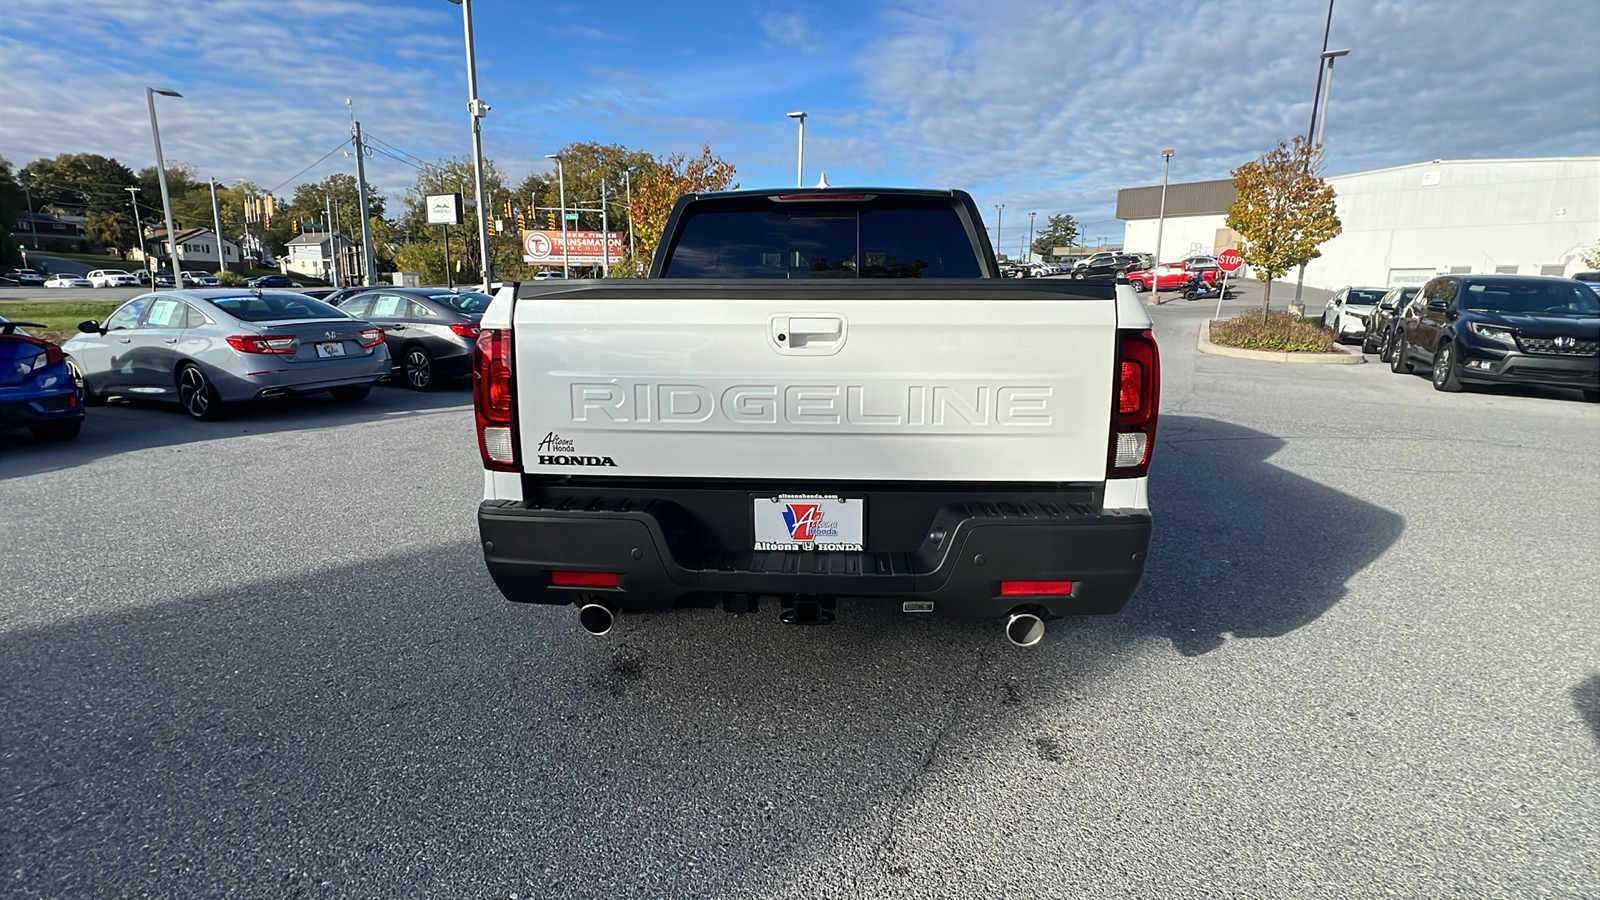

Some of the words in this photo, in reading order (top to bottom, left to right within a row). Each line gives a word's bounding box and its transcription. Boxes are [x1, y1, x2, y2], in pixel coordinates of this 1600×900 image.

[553, 238, 622, 247] TRNS4MATON
[1218, 255, 1242, 265] STOP
[569, 382, 1054, 427] RIDGELINE
[537, 431, 574, 452] Altoona
[537, 455, 618, 467] HONDA
[792, 506, 838, 537] Altoona
[810, 528, 837, 536] Honda
[754, 542, 799, 551] Altoona
[817, 543, 863, 551] HONDA
